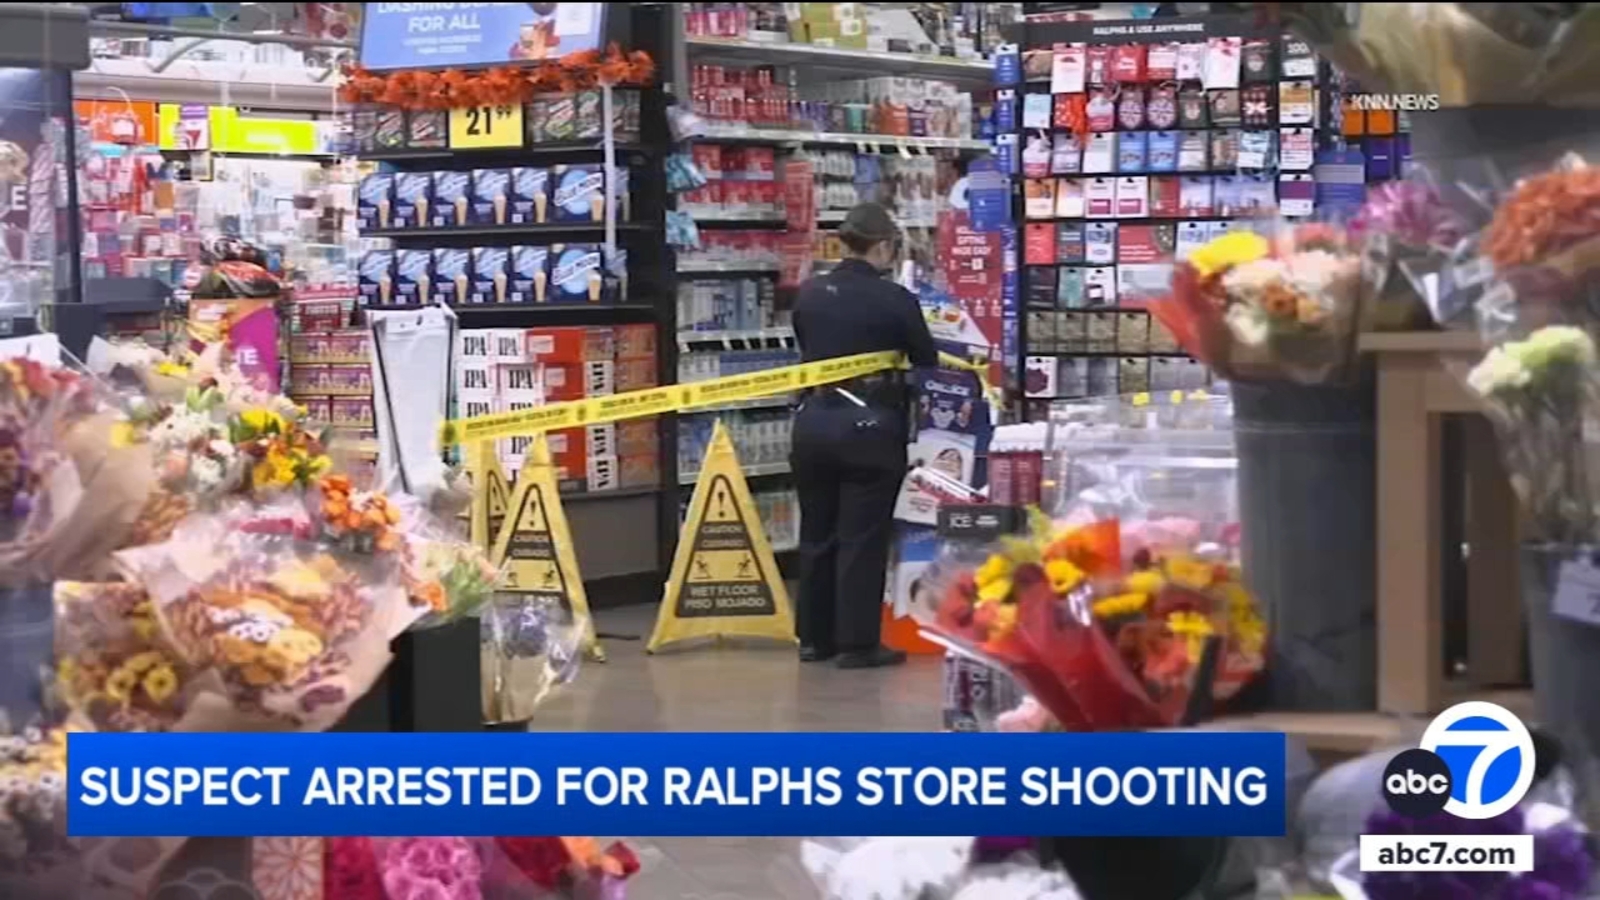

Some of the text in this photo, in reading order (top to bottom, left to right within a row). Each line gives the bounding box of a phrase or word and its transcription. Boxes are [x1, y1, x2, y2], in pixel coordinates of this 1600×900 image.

[408, 14, 480, 32] FOR ALL
[466, 107, 493, 135] 21
[464, 337, 487, 356] IPA
[499, 337, 519, 356] IPA
[464, 369, 487, 388] IPA
[508, 369, 534, 389] IPA
[691, 584, 758, 597] WET FLOOR
[717, 596, 765, 608] MOJADO
